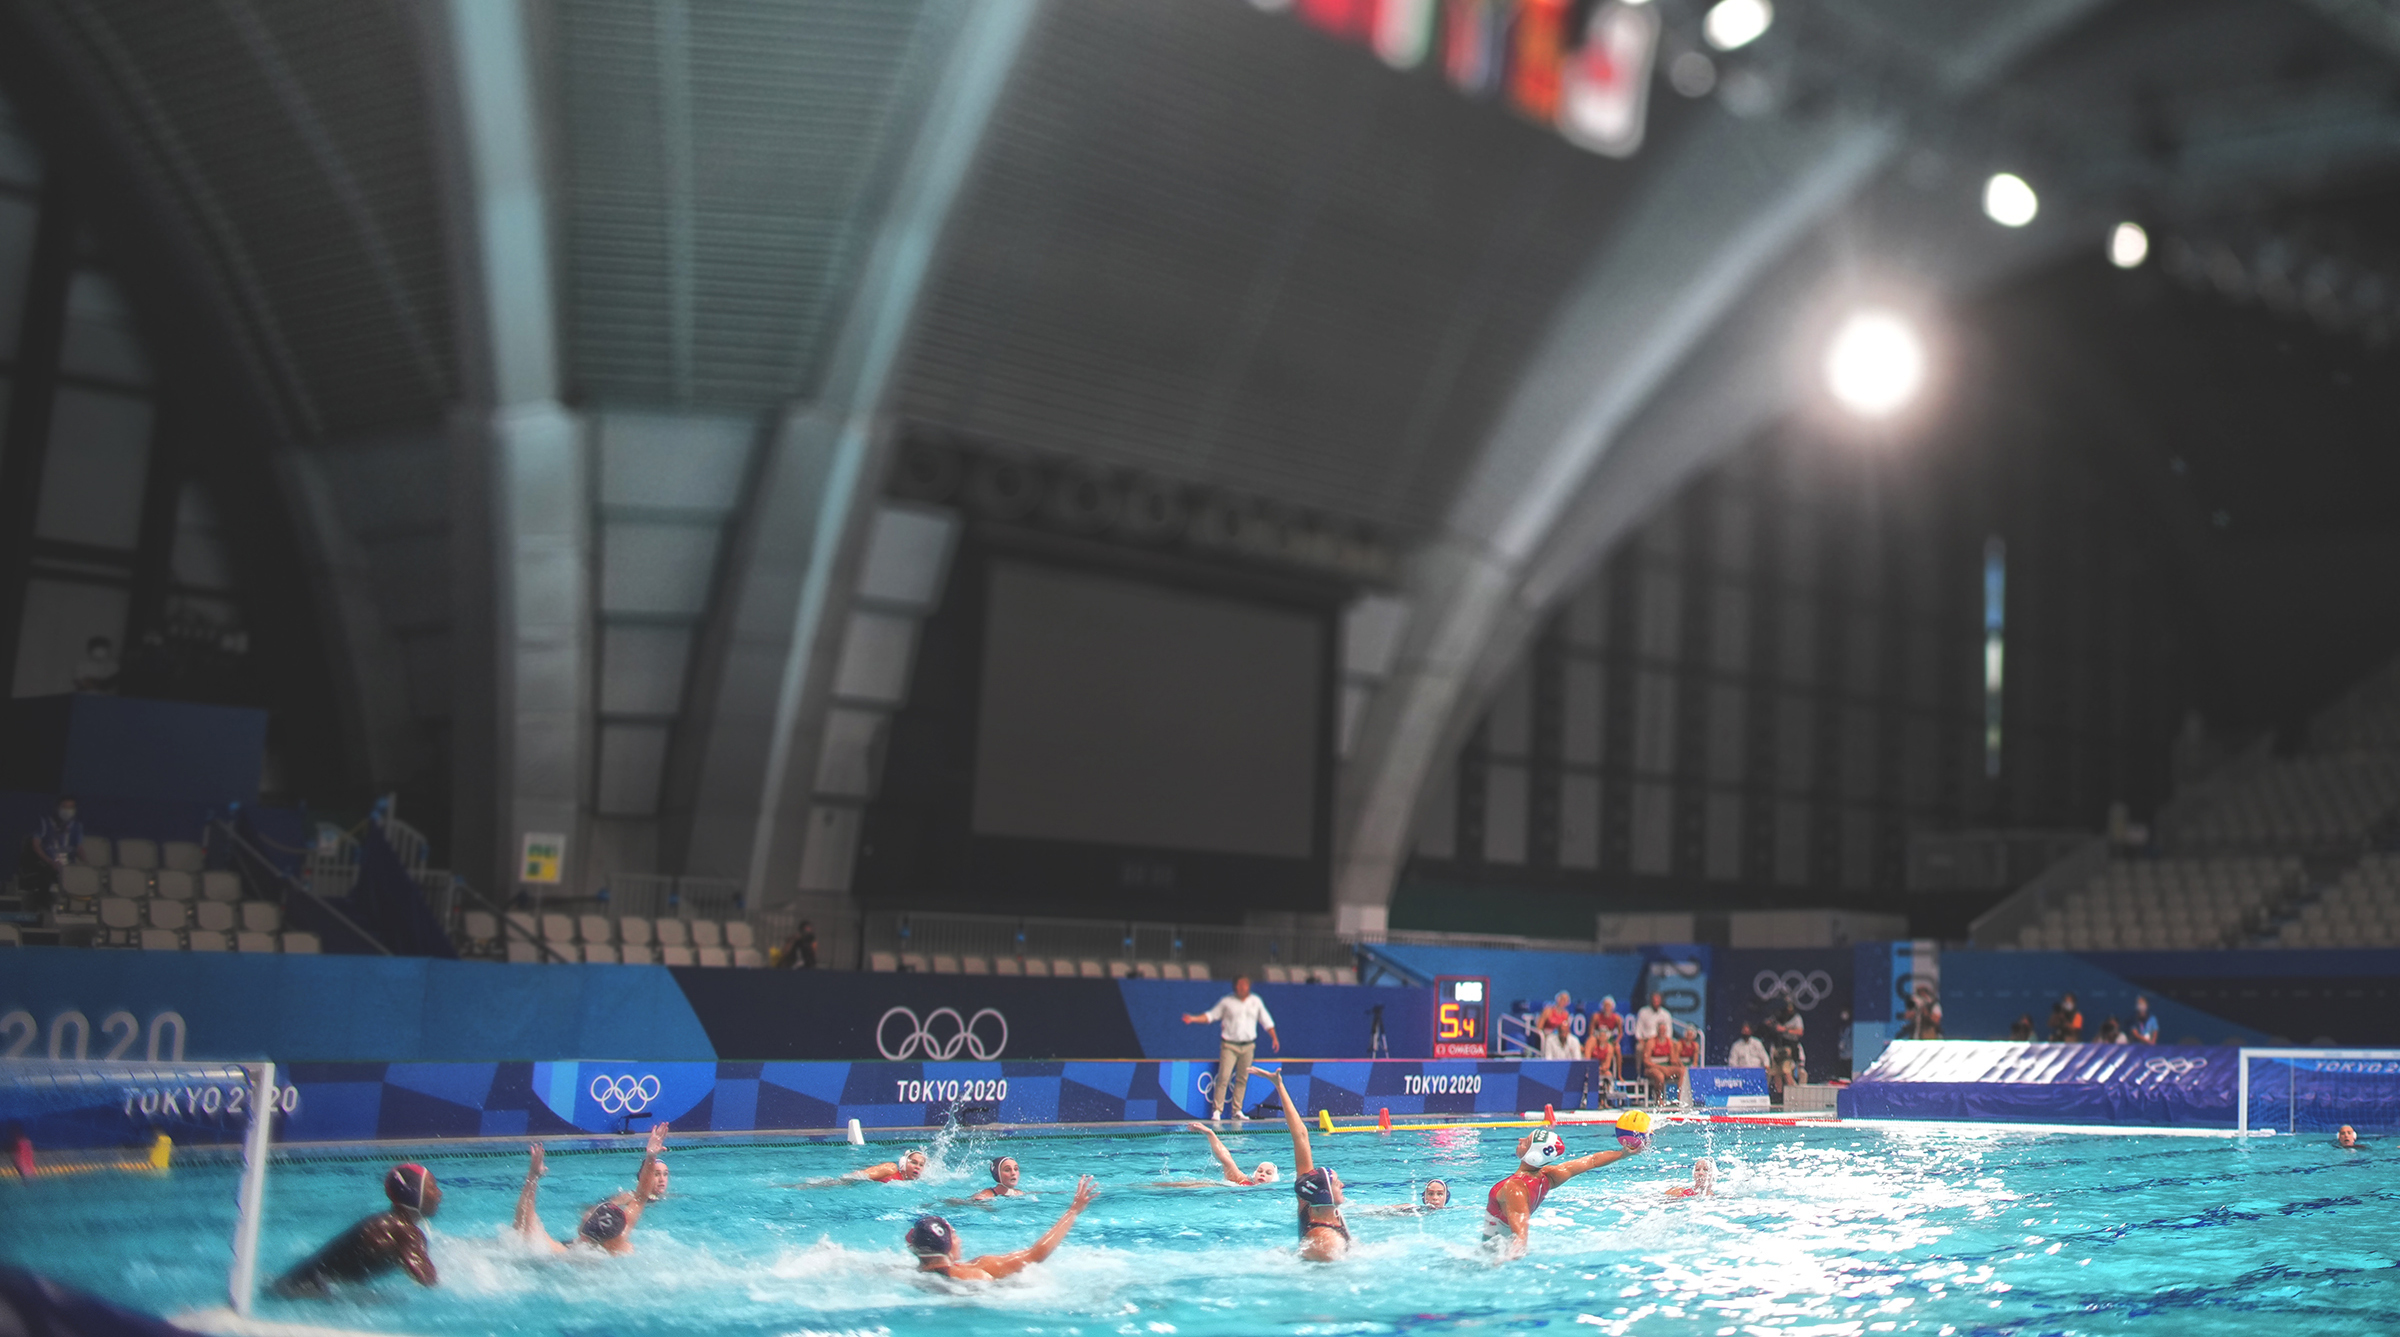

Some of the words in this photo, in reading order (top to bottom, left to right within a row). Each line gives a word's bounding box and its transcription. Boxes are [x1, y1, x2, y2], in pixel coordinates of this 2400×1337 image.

[0, 1011, 187, 1062] 2020
[1448, 1043, 1485, 1056] OMEGA
[2315, 1061, 2382, 1073] TOKYO
[897, 1080, 959, 1102] TOKYO
[962, 1079, 1008, 1101] 2020
[1404, 1075, 1448, 1095] TOKYO
[1449, 1074, 1482, 1094] 2020
[124, 1087, 222, 1116] TOKYO
[226, 1086, 299, 1113] 220
[1542, 1145, 1555, 1157] 8
[1301, 1180, 1319, 1195] 11
[598, 1212, 613, 1231] 12
[930, 1223, 945, 1238] 6
